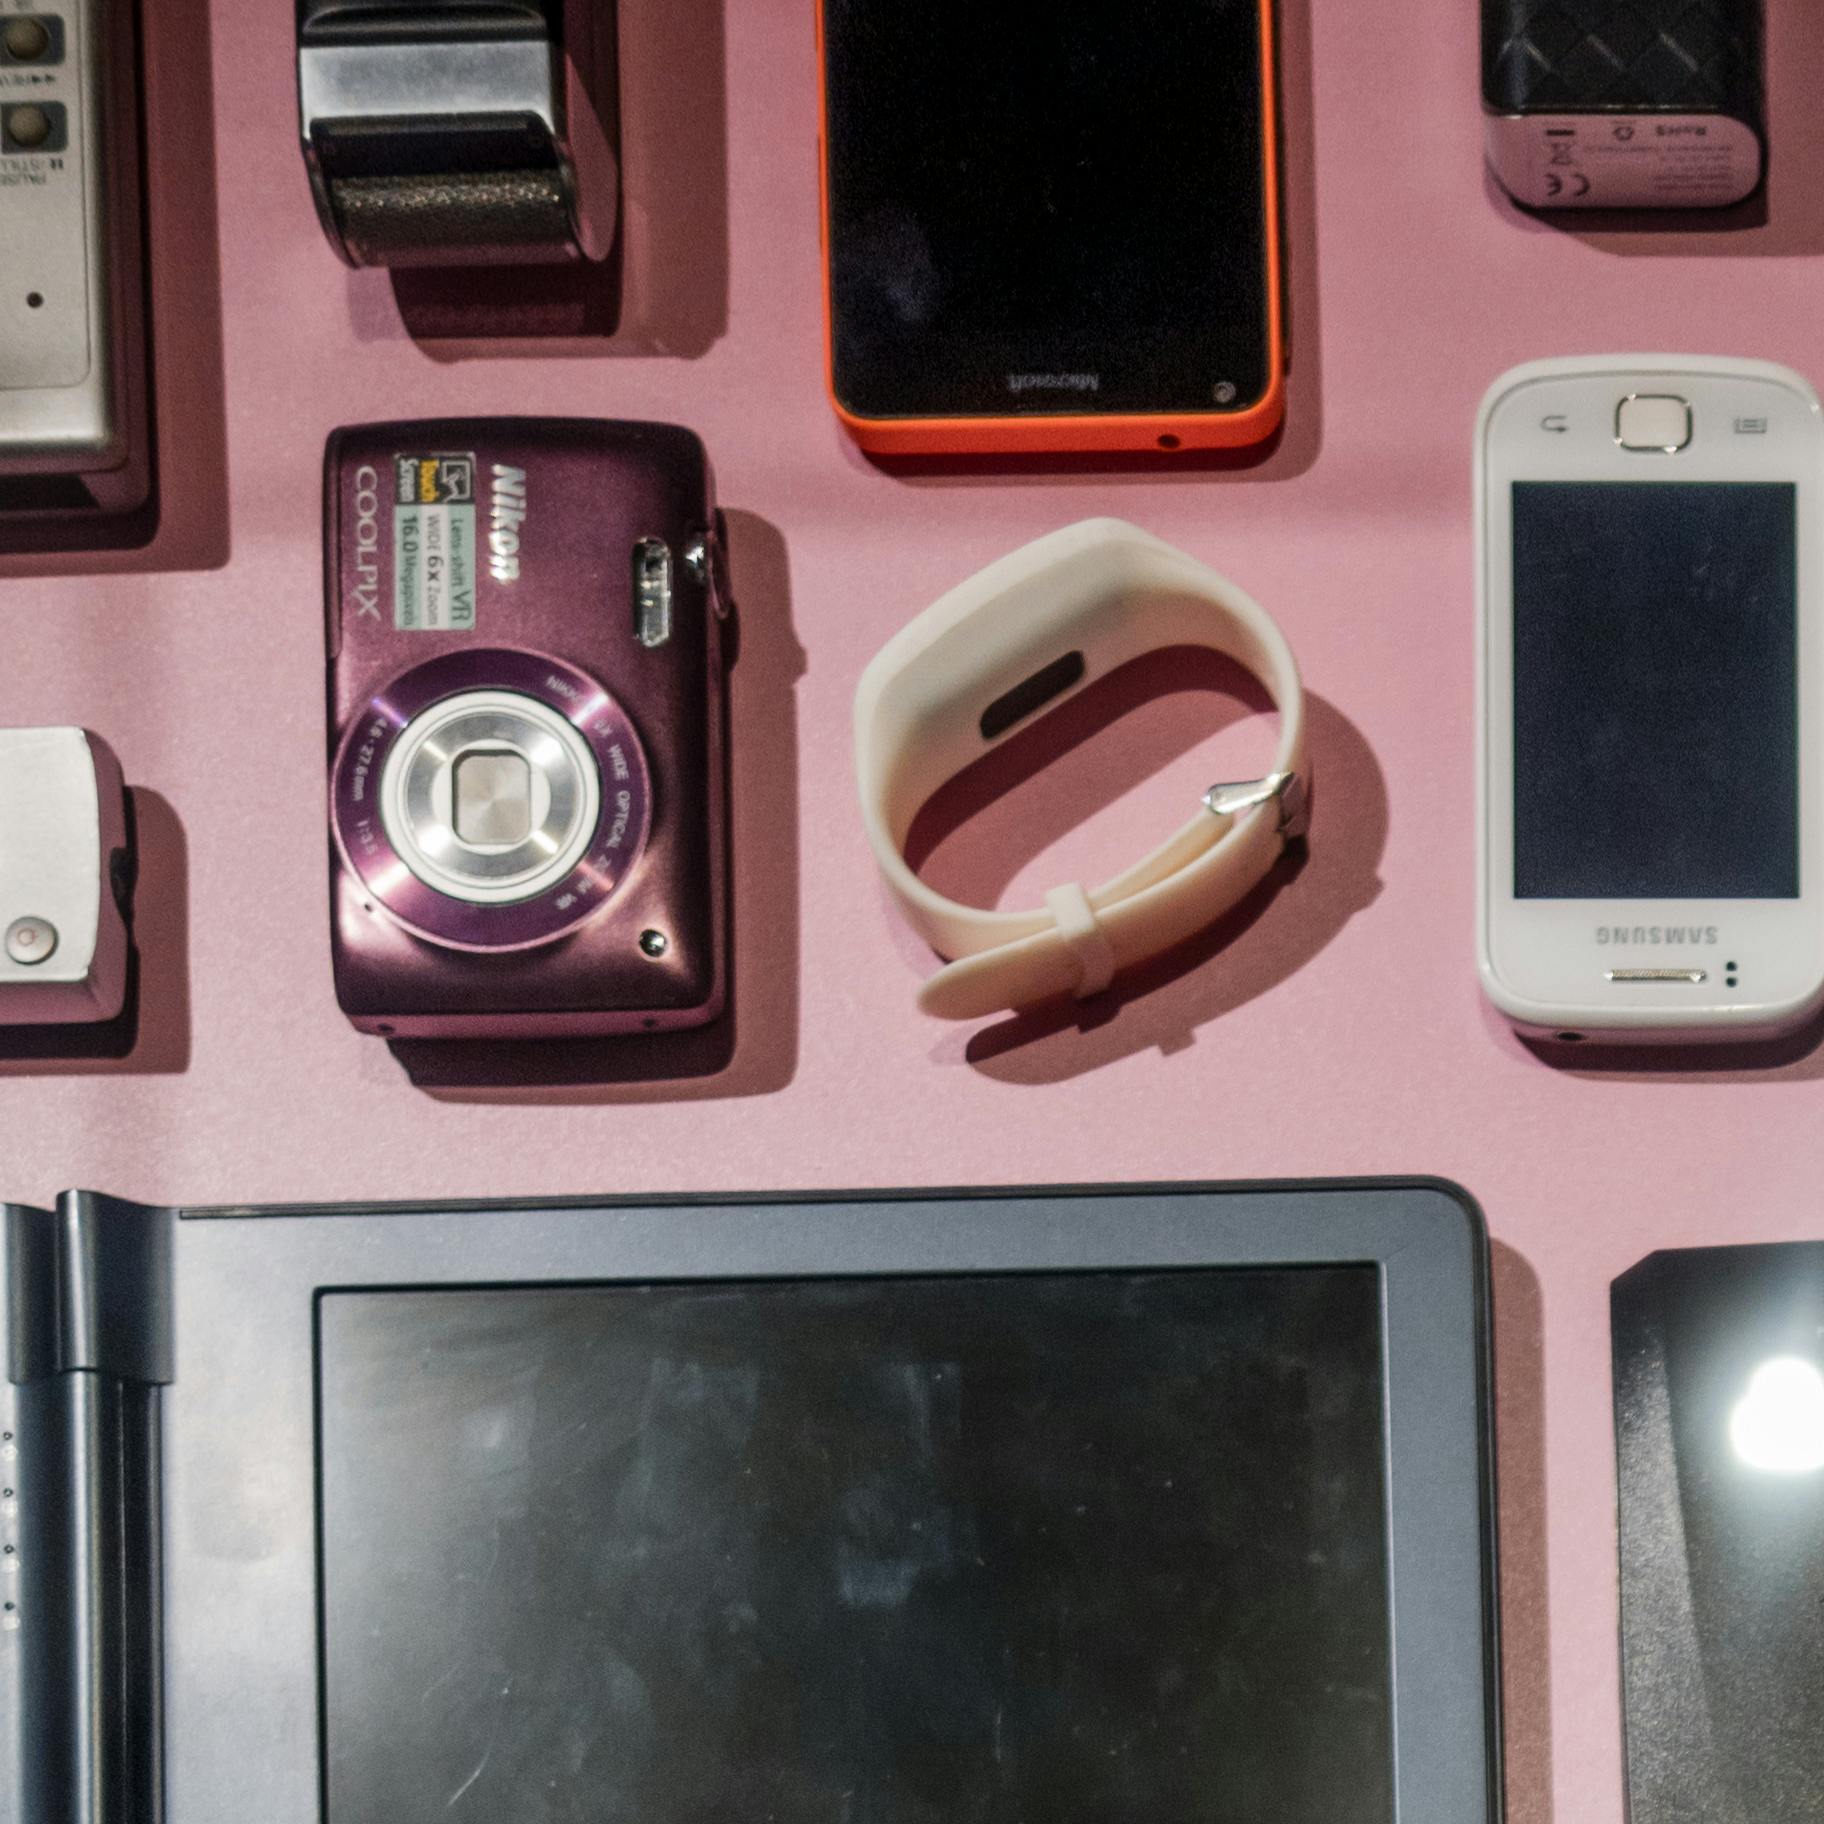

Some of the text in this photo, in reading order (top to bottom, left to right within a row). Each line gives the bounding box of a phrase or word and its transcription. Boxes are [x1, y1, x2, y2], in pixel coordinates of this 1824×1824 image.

[399, 458, 418, 503] Screen
[420, 459, 439, 503] Touch
[352, 465, 381, 621] COOLPIX
[427, 514, 440, 551] WIDE
[489, 464, 527, 582] Nikon
[400, 515, 418, 626] 16.0 Megapixels
[427, 586, 438, 626] Zoom
[452, 590, 472, 621] VR
[1595, 925, 1719, 945] SAMSUNG
